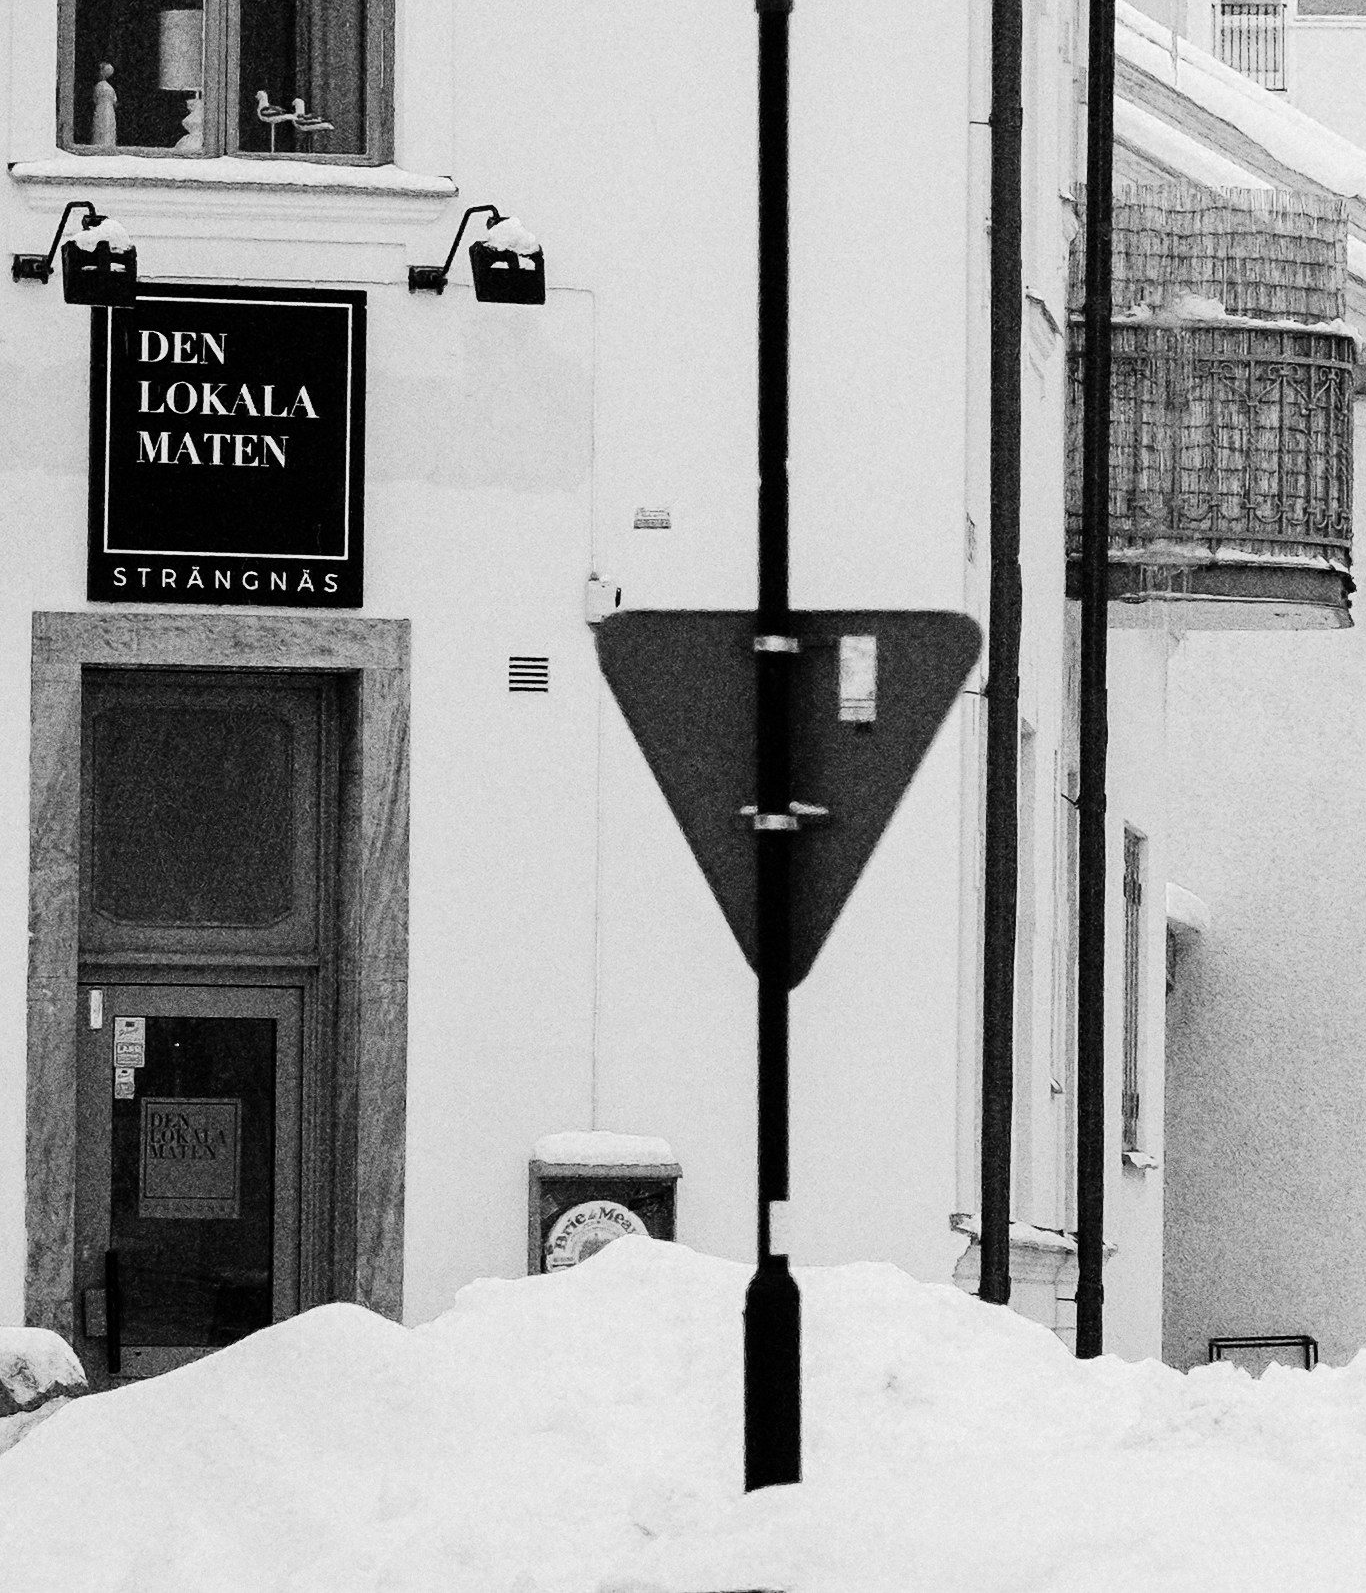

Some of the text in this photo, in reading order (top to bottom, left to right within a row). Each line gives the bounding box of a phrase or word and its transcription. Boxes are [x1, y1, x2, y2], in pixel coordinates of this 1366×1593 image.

[138, 330, 227, 364] DEN
[138, 381, 320, 419] LOKALA
[136, 430, 289, 468] MATEN
[112, 566, 339, 593] STRÄNGNÄS
[150, 1112, 190, 1129] DEN
[149, 1128, 227, 1145] LOKALA
[149, 1144, 217, 1160] MATEN
